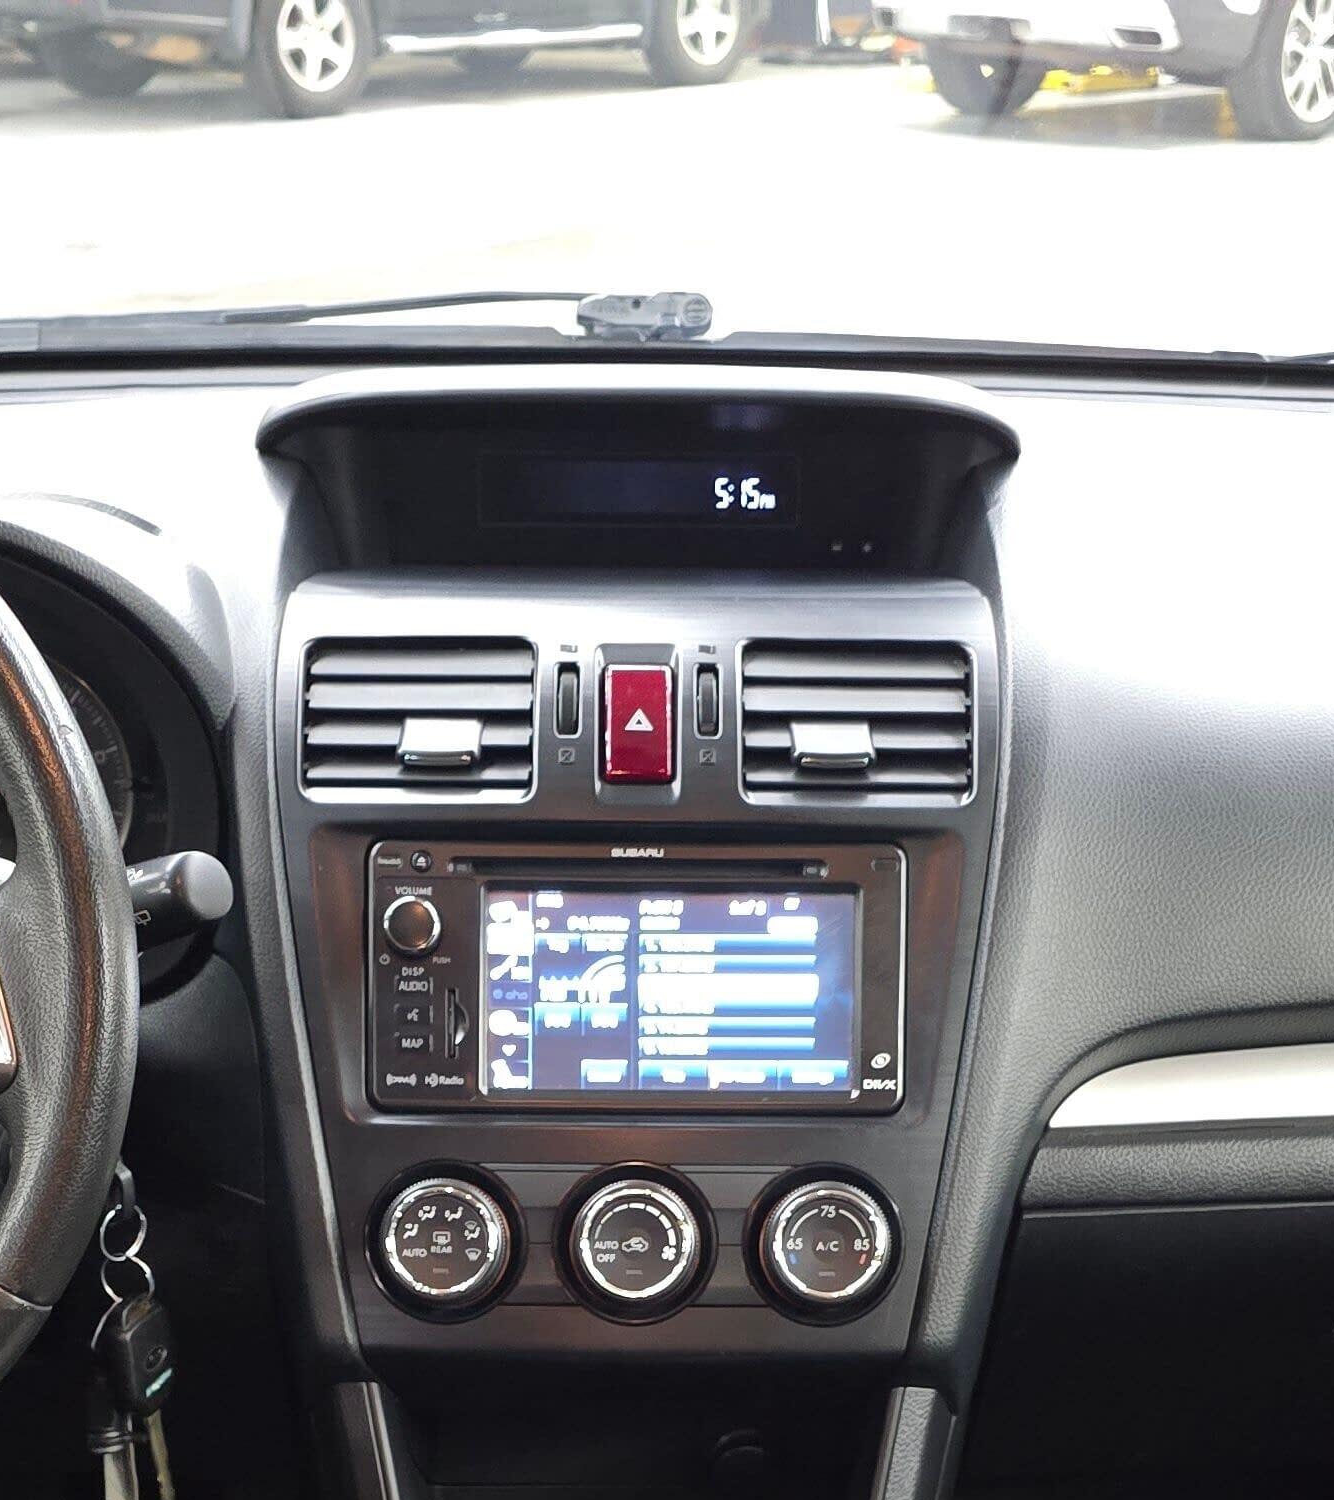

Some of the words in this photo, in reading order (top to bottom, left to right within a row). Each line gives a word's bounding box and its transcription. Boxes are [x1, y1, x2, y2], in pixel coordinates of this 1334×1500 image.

[610, 847, 665, 857] SUBARU
[395, 886, 433, 896] VOLUME
[401, 966, 425, 977] DISP
[398, 980, 429, 992] AUDIO
[401, 1038, 424, 1049] MAP
[438, 1075, 465, 1086] Radio
[820, 1205, 836, 1218] 75
[430, 1245, 453, 1254] REAR
[593, 1240, 619, 1250] AUTO
[786, 1238, 803, 1250] 65
[815, 1240, 839, 1252] A/C
[853, 1238, 870, 1251] 85
[401, 1247, 427, 1258] AUTO
[596, 1253, 616, 1263] OFF
